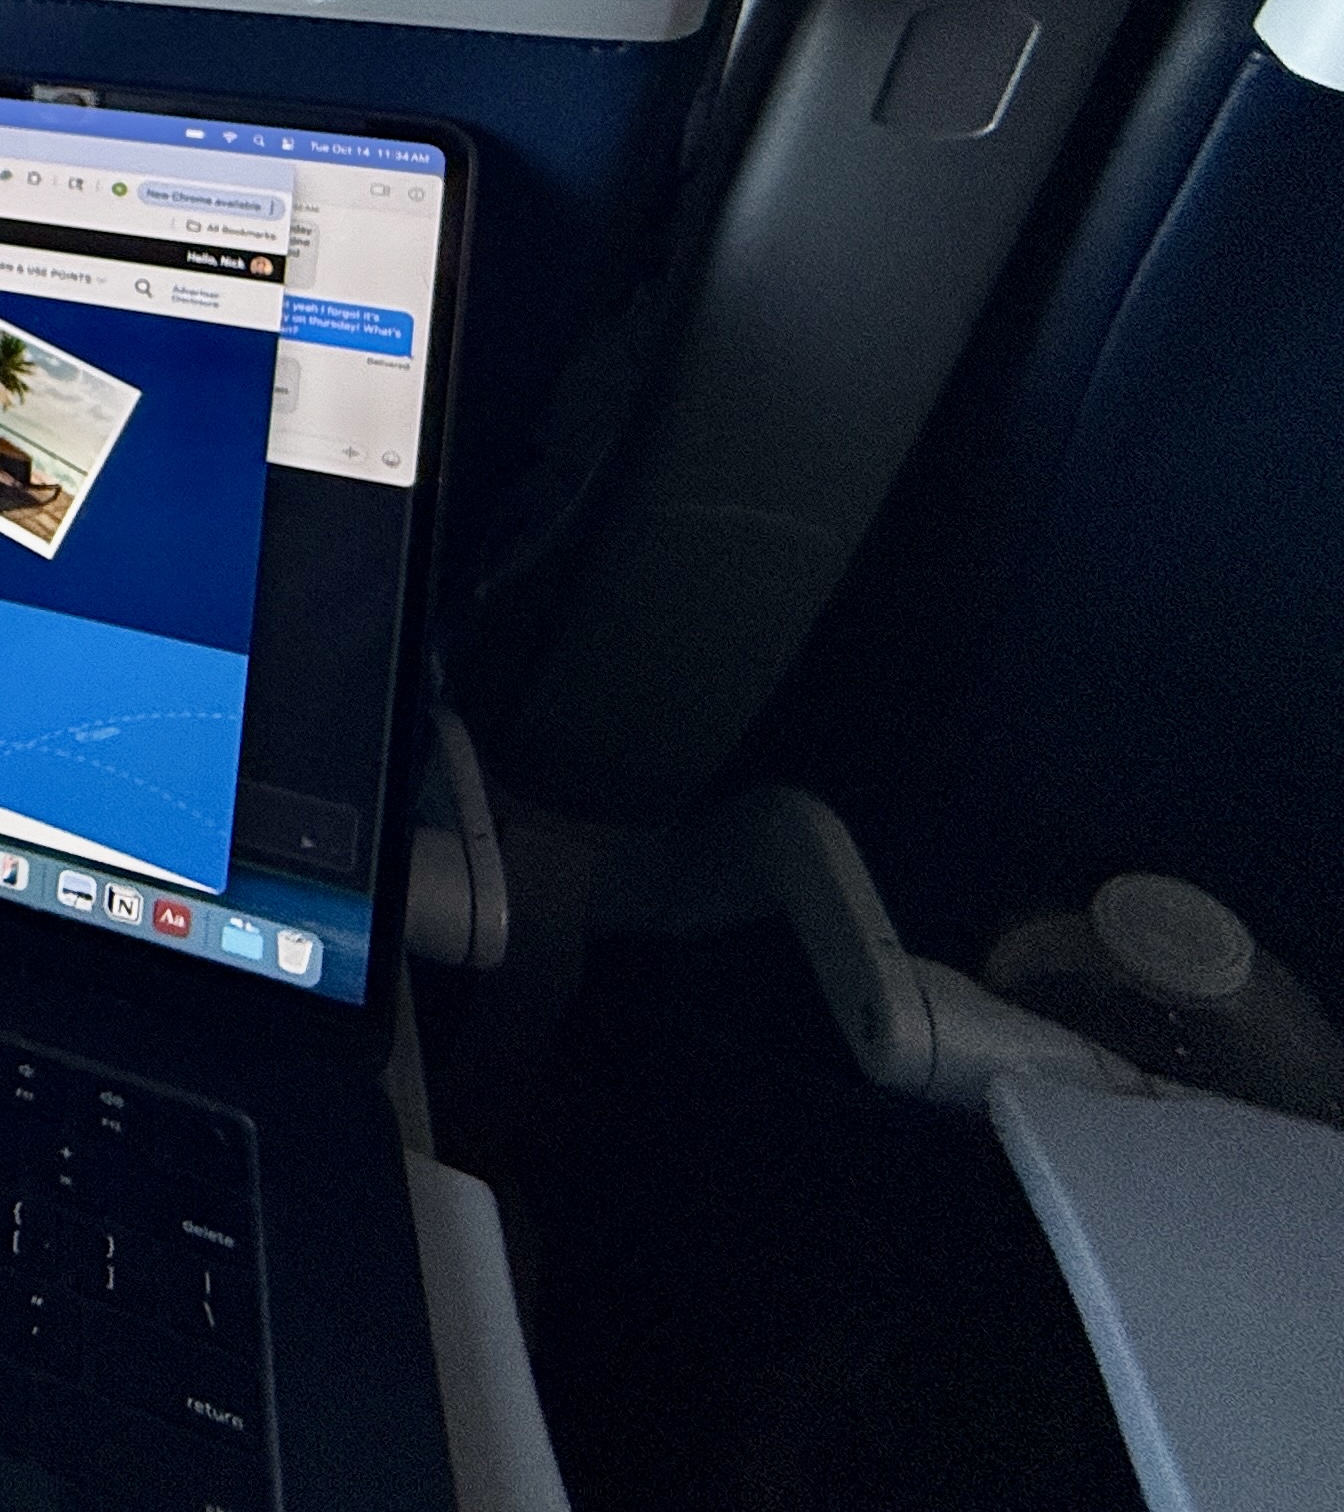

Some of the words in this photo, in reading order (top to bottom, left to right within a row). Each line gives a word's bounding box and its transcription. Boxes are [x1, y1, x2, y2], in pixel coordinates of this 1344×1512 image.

[159, 907, 186, 929] Aa
[181, 1218, 236, 1249] delete
[187, 1395, 244, 1431] return
